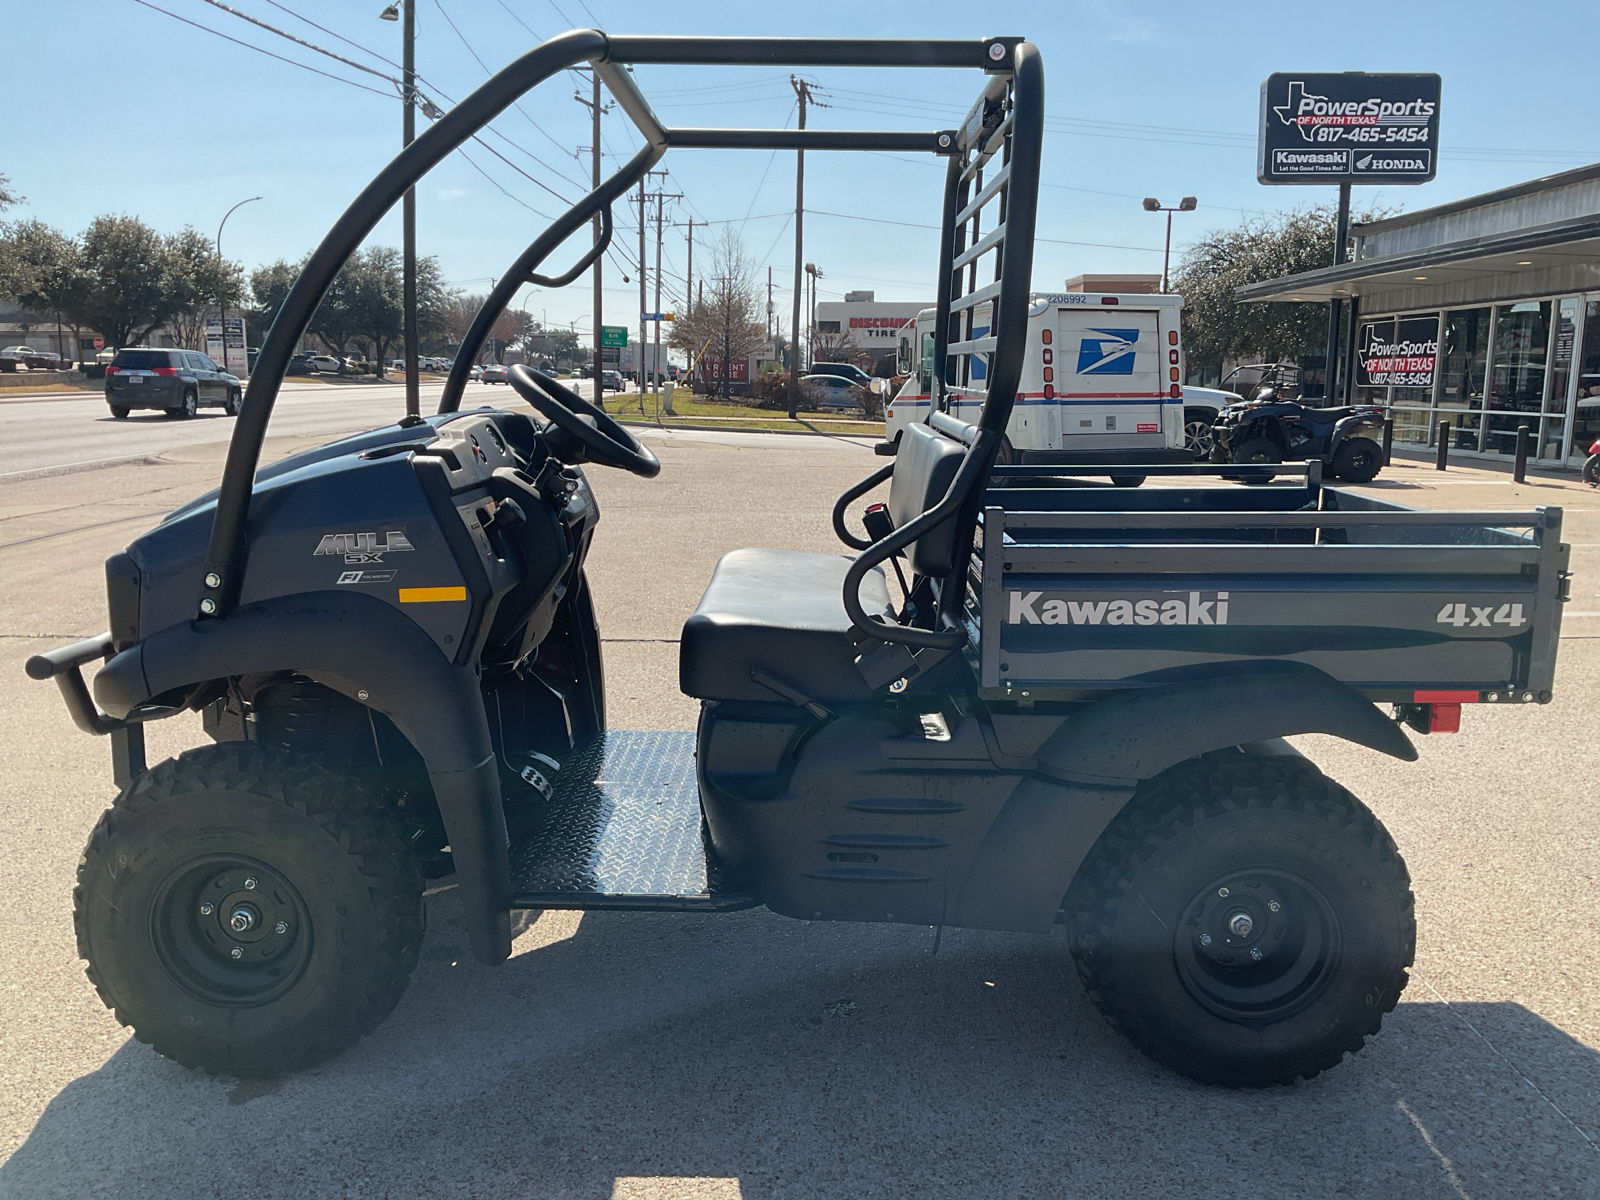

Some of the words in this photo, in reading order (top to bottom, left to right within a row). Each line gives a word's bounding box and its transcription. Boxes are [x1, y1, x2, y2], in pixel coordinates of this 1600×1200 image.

[1297, 98, 1435, 118] PowerSports
[1297, 117, 1311, 125] OF
[1311, 117, 1345, 125] NORTH
[1346, 117, 1377, 125] TEXAS
[1317, 127, 1429, 142] 817-465-5454
[1276, 152, 1347, 163] Kawasaki
[1372, 159, 1425, 169] HONDA
[1046, 294, 1086, 304] 2208992
[867, 329, 896, 337] TIRE
[1368, 339, 1438, 357] PowerSports
[1366, 358, 1378, 371] OF
[1406, 358, 1434, 371] TEXAS
[313, 531, 415, 556] MULE
[344, 552, 384, 565] SX
[340, 571, 362, 583] FI
[1008, 591, 1229, 625] Kawasaki
[1436, 603, 1527, 627] 4x4
